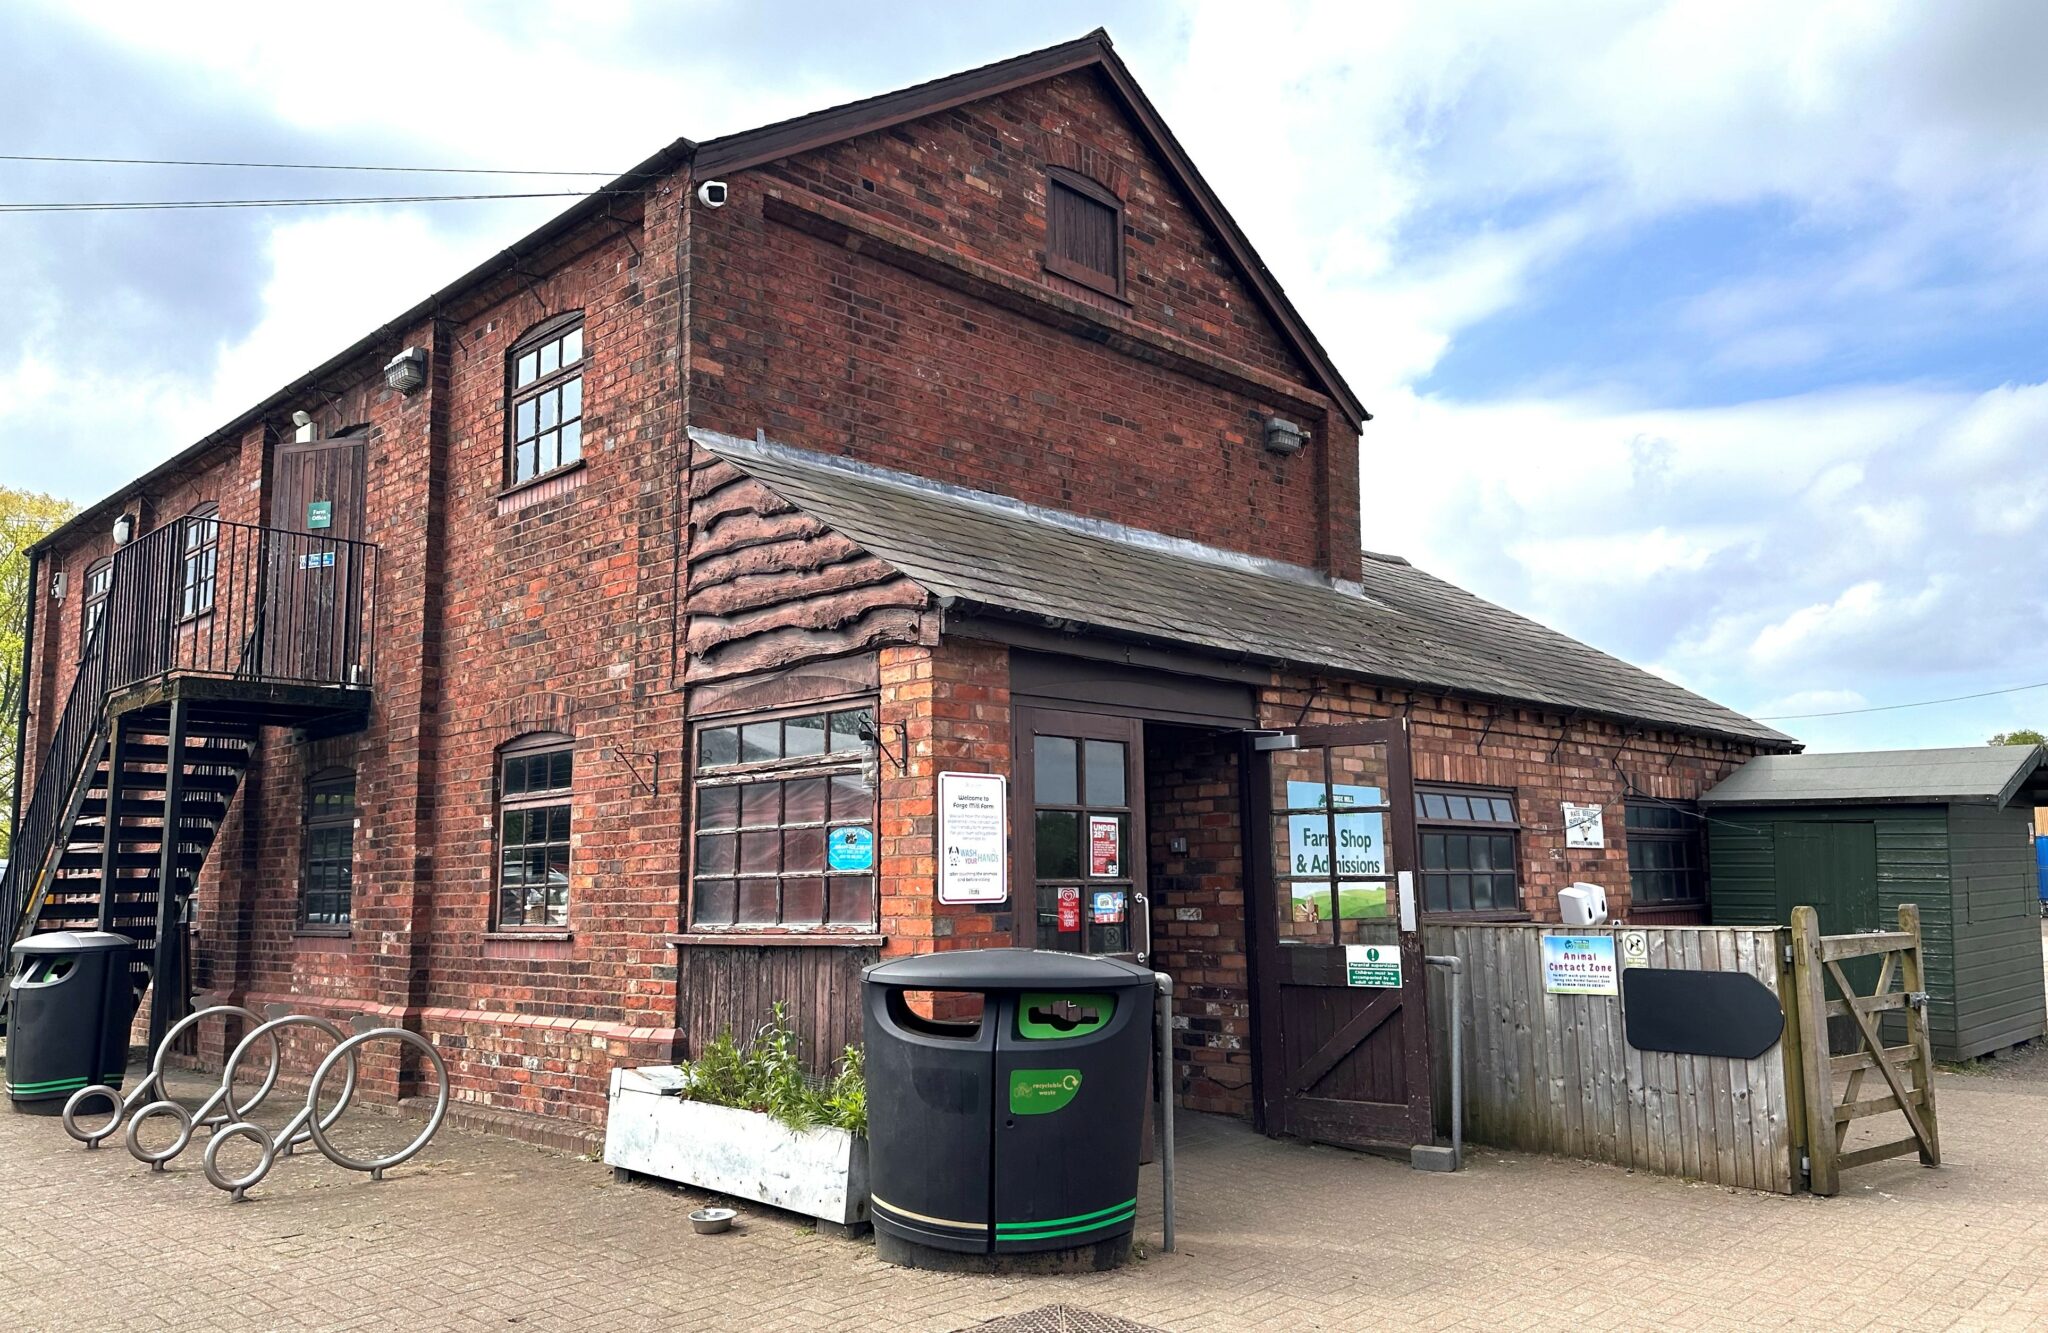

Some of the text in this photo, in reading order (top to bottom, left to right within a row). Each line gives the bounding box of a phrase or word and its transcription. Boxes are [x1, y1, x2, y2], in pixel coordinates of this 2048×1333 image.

[952, 802, 968, 810] Forge
[1093, 824, 1116, 832] UNDER
[1093, 831, 1105, 839] 25?
[1340, 828, 1372, 853] Shop
[960, 848, 977, 857] WASH
[978, 853, 999, 862] HANDS
[1296, 854, 1308, 874] &
[1108, 864, 1118, 874] 25
[1064, 910, 1074, 919] SOLD
[1564, 952, 1596, 960] Animal
[1550, 962, 1612, 972] Contact Zone
